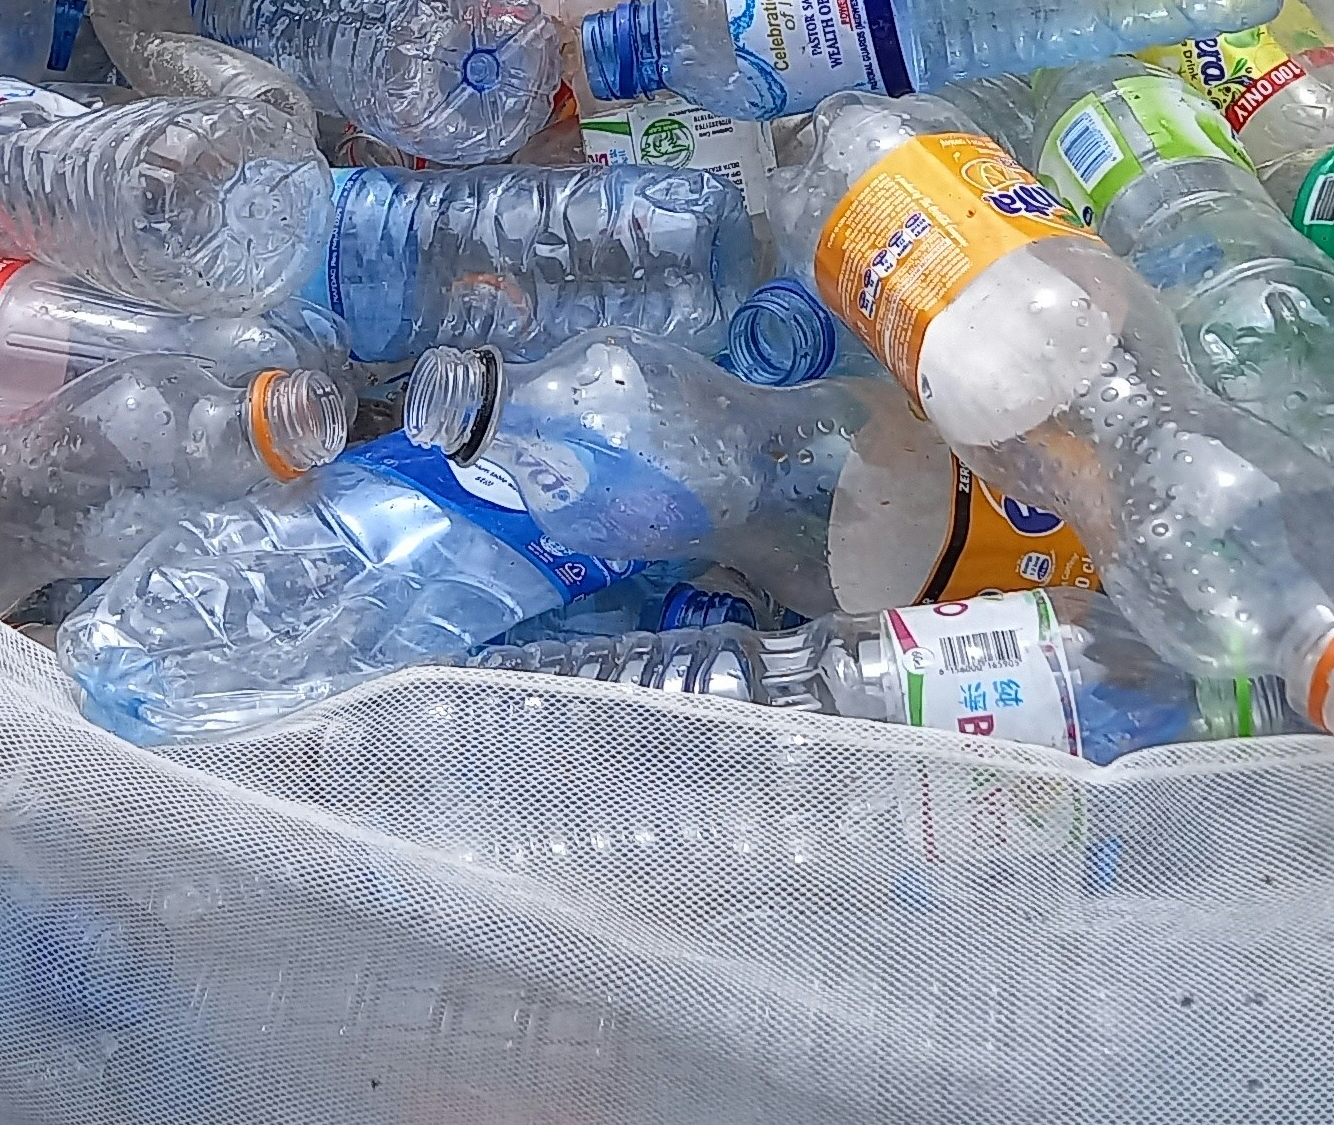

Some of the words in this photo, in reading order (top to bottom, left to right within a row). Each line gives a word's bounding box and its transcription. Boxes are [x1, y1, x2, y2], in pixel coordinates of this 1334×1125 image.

[778, 8, 795, 31] of
[805, 13, 823, 57] PASTOR
[822, 18, 843, 69] WEALTH
[1182, 49, 1199, 81] Drink
[1270, 61, 1302, 86] 100
[1233, 79, 1274, 123] ONLY
